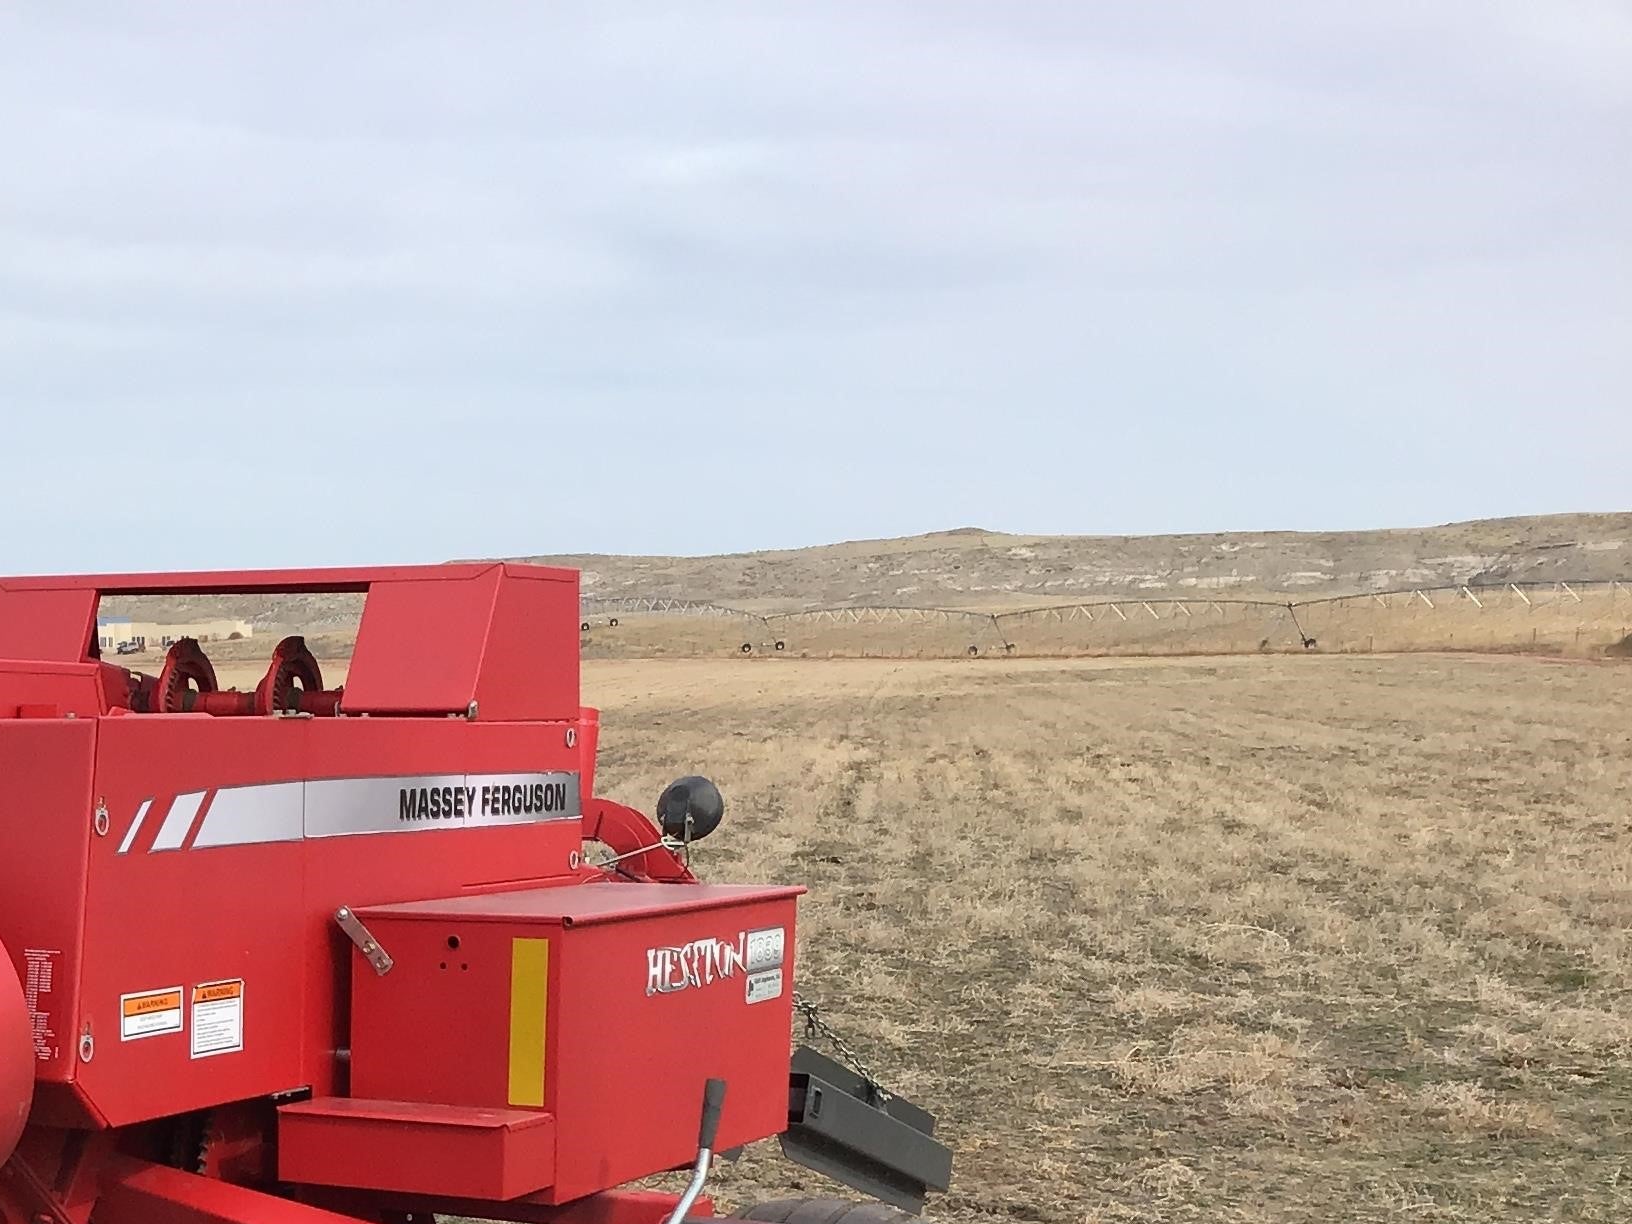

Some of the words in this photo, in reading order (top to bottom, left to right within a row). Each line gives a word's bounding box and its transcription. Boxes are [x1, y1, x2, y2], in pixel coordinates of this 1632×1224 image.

[399, 787, 476, 821] MASSEY
[481, 783, 566, 816] FERGUSON
[646, 932, 746, 996] HESSTON
